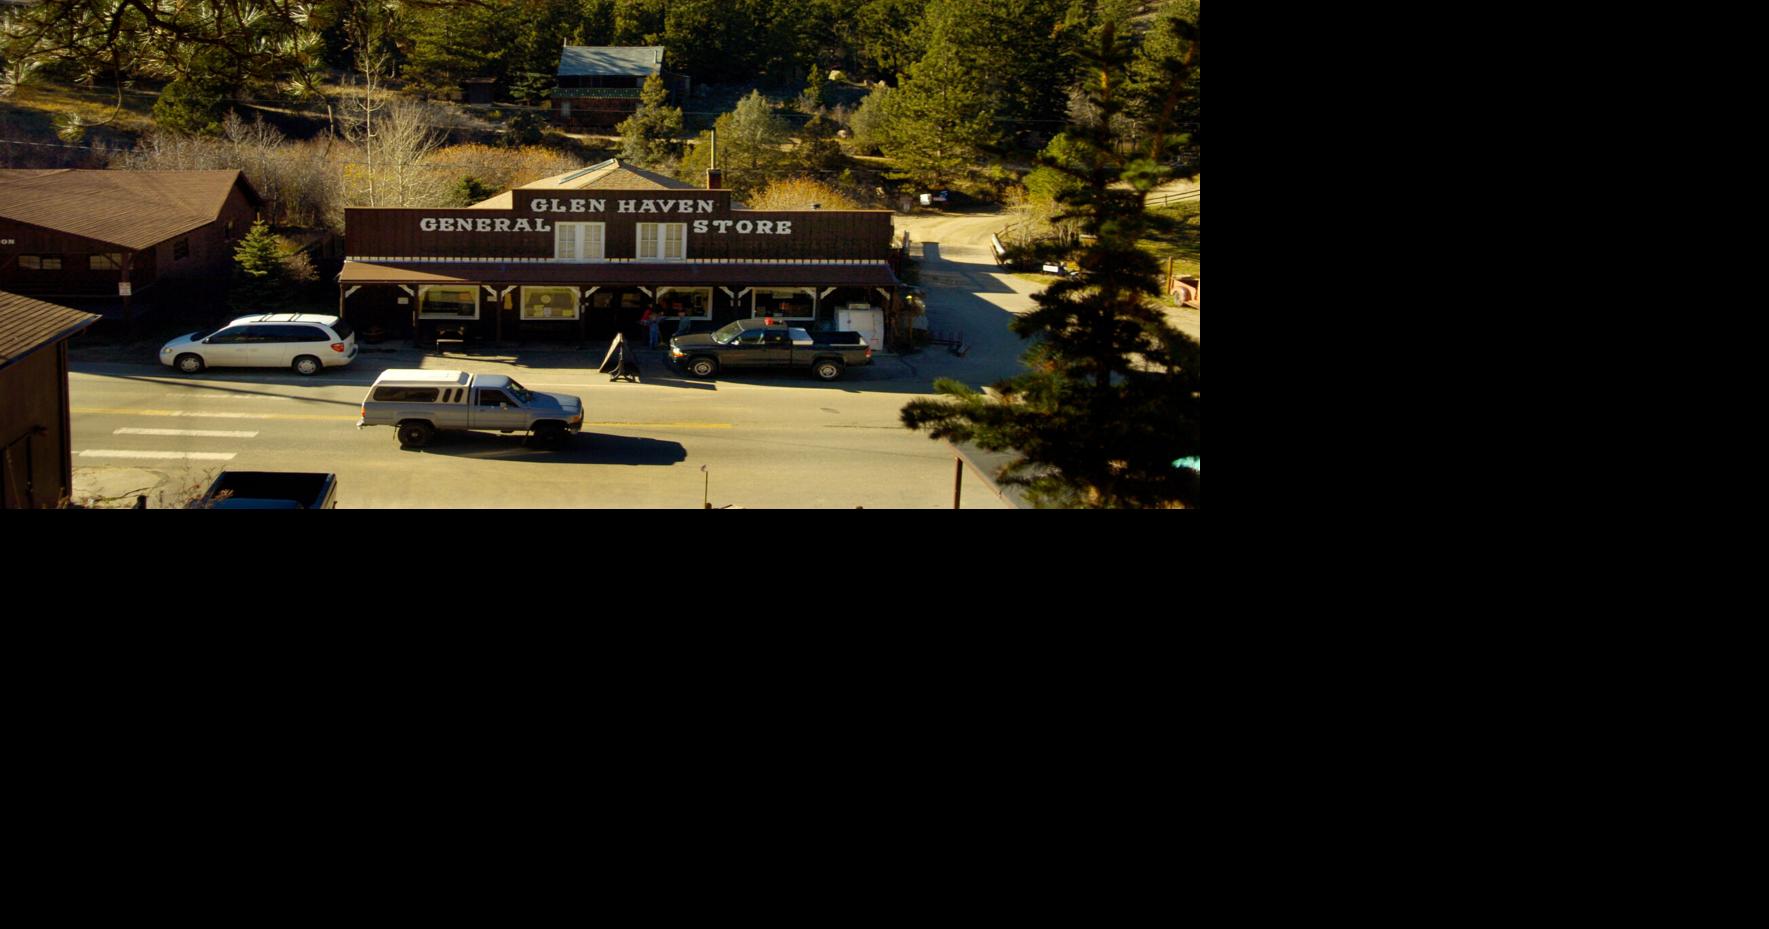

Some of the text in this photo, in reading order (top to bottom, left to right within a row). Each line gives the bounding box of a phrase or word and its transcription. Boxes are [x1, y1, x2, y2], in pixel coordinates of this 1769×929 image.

[530, 198, 714, 214] GLEN HAVEN
[419, 218, 792, 234] GENERAL STORE
